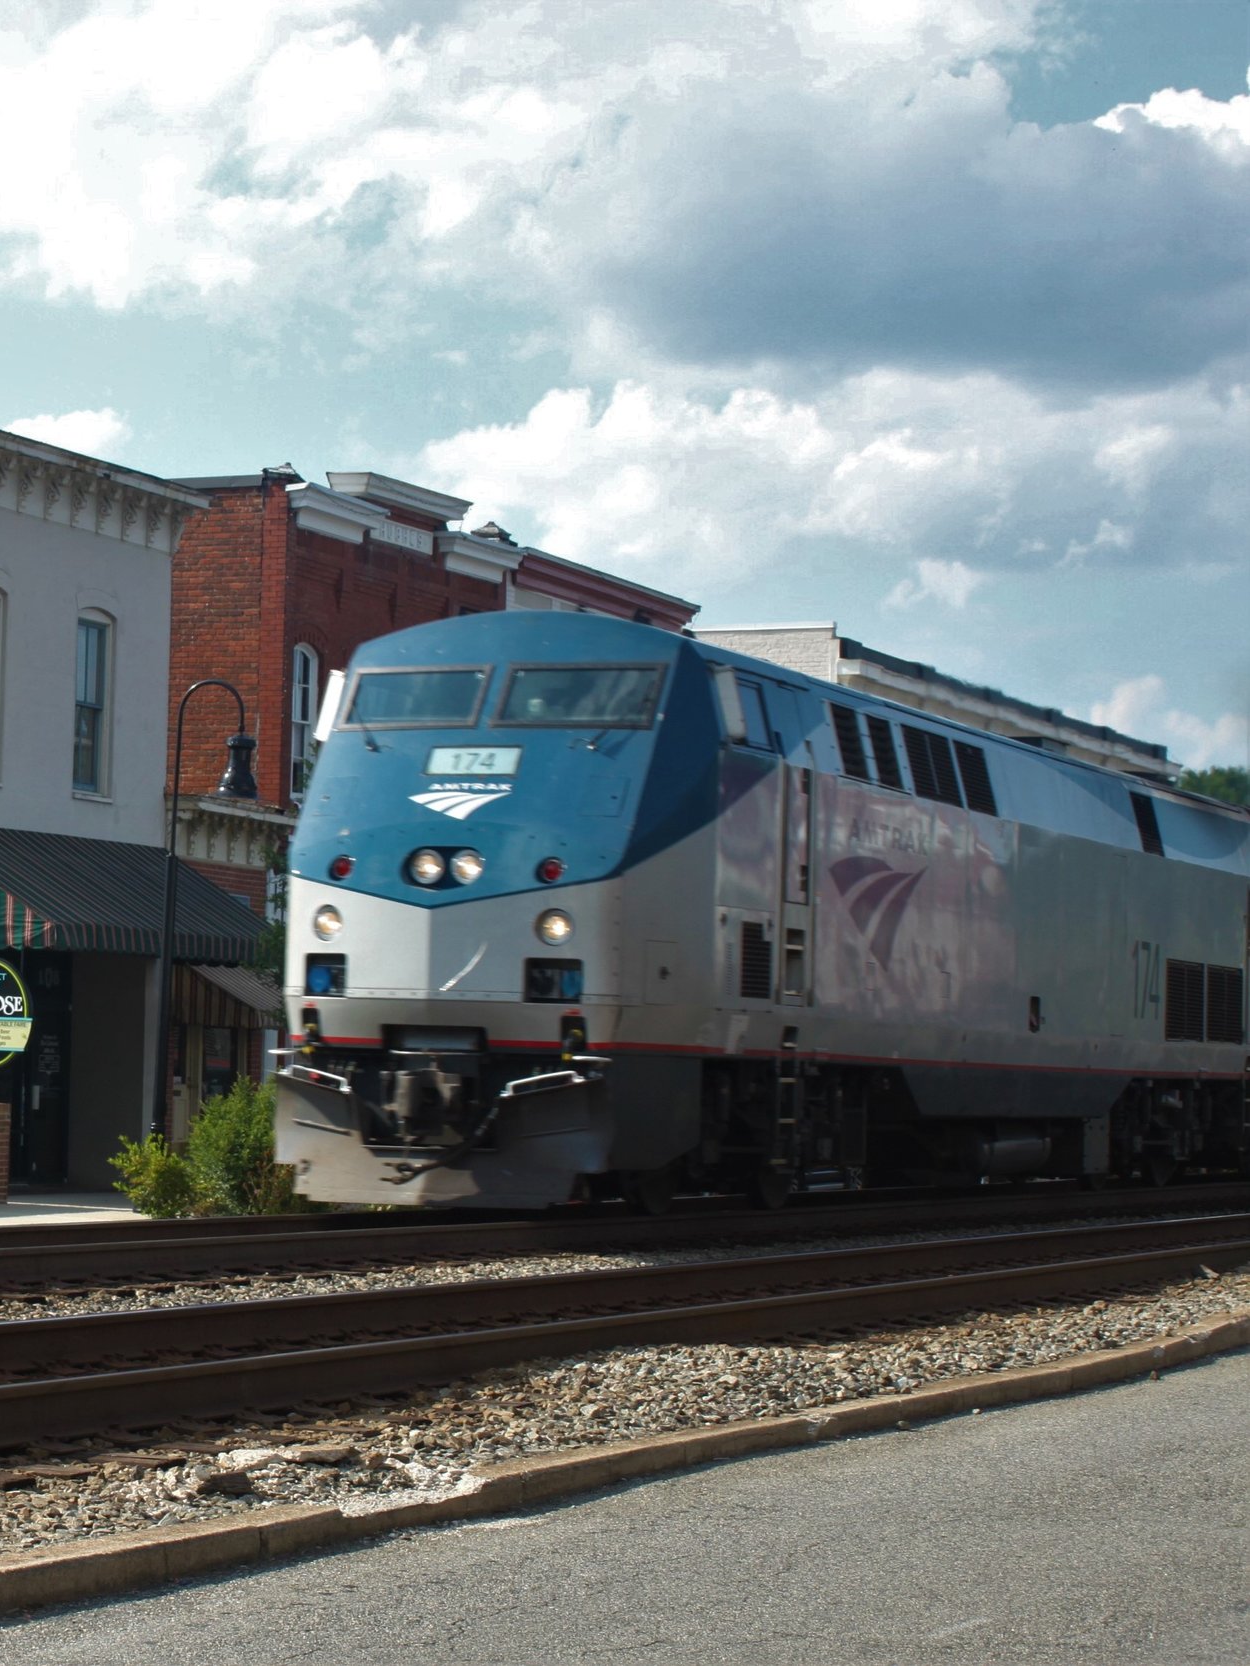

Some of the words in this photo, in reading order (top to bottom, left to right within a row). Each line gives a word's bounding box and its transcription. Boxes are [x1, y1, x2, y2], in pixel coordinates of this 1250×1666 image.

[451, 752, 496, 771] 174
[428, 783, 512, 791] AMTRAK
[848, 817, 928, 857] AMTRAK
[1132, 940, 1160, 1020] 174
